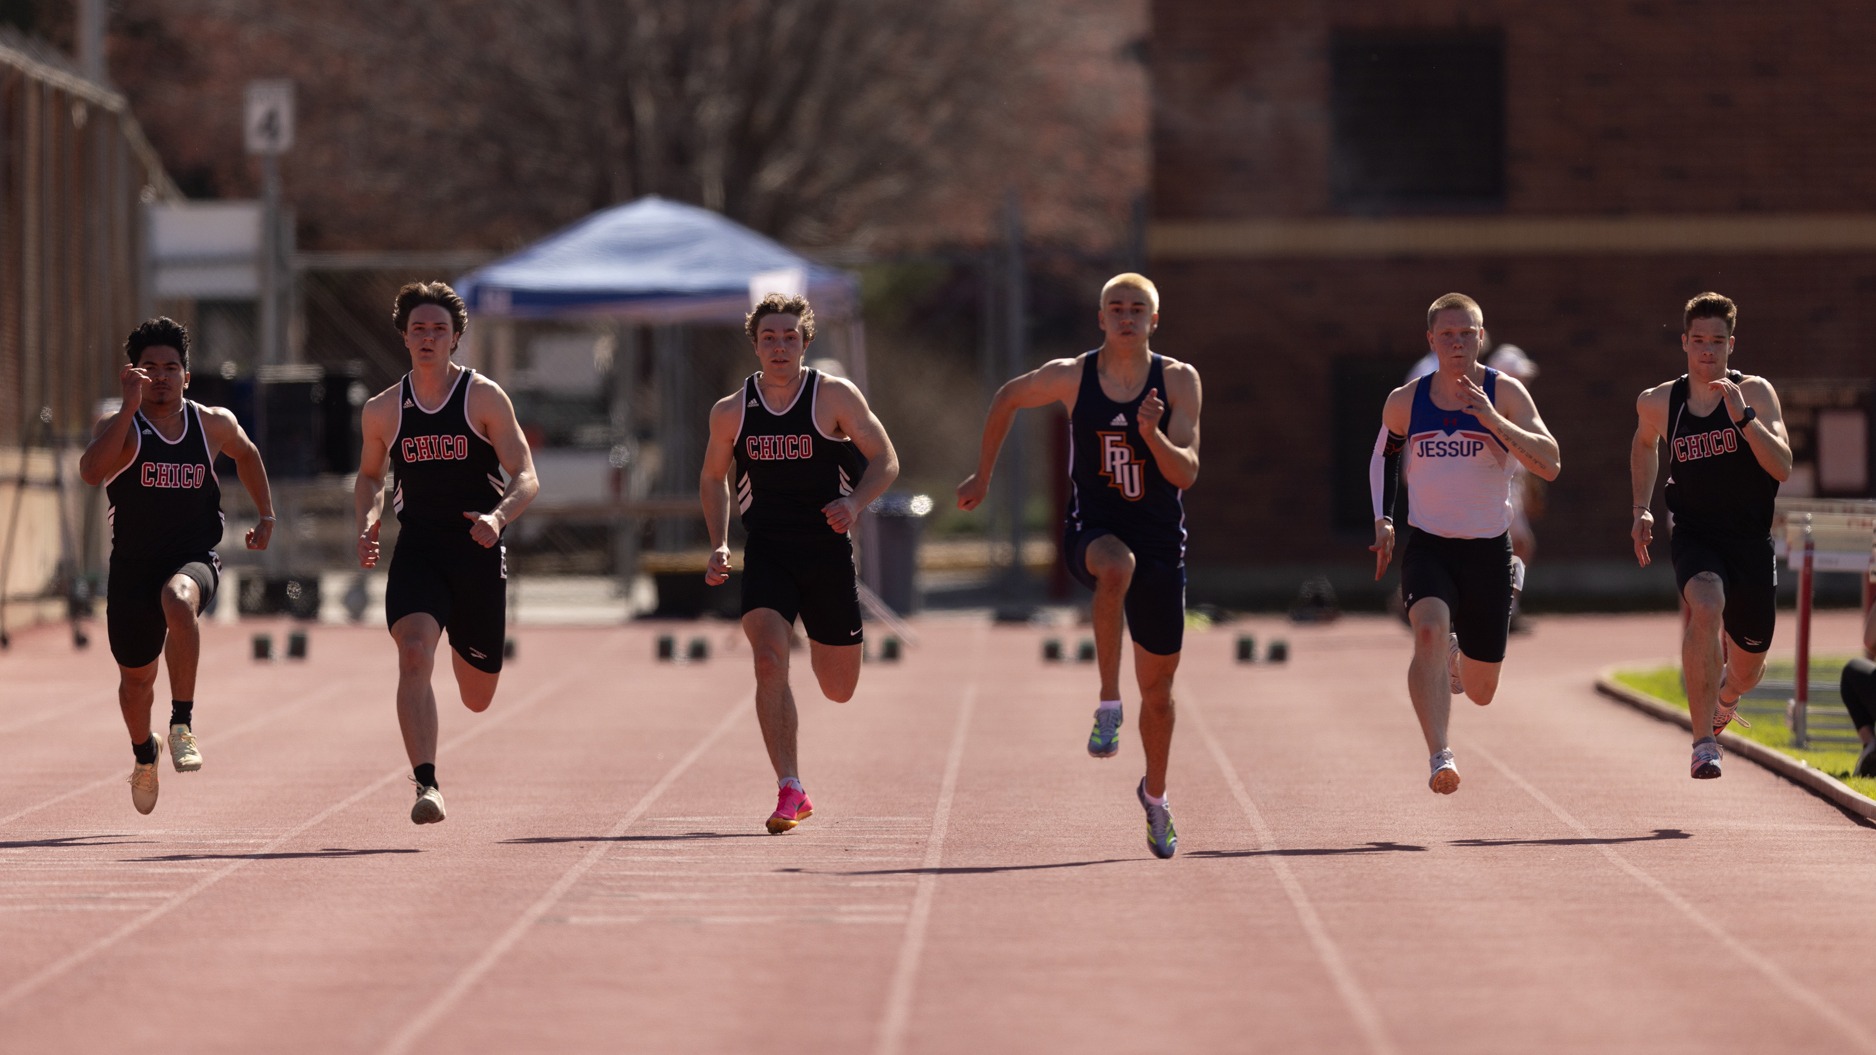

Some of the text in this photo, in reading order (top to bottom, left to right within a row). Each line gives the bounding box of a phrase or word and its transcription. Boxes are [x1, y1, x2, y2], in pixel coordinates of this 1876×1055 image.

[255, 107, 282, 142] 4
[401, 434, 468, 463] CHICO
[746, 434, 813, 460] CHICO
[1417, 440, 1484, 458] JESSUP
[1674, 427, 1738, 462] CHICO
[140, 461, 206, 489] CHICO
[1098, 432, 1145, 501] FPU
